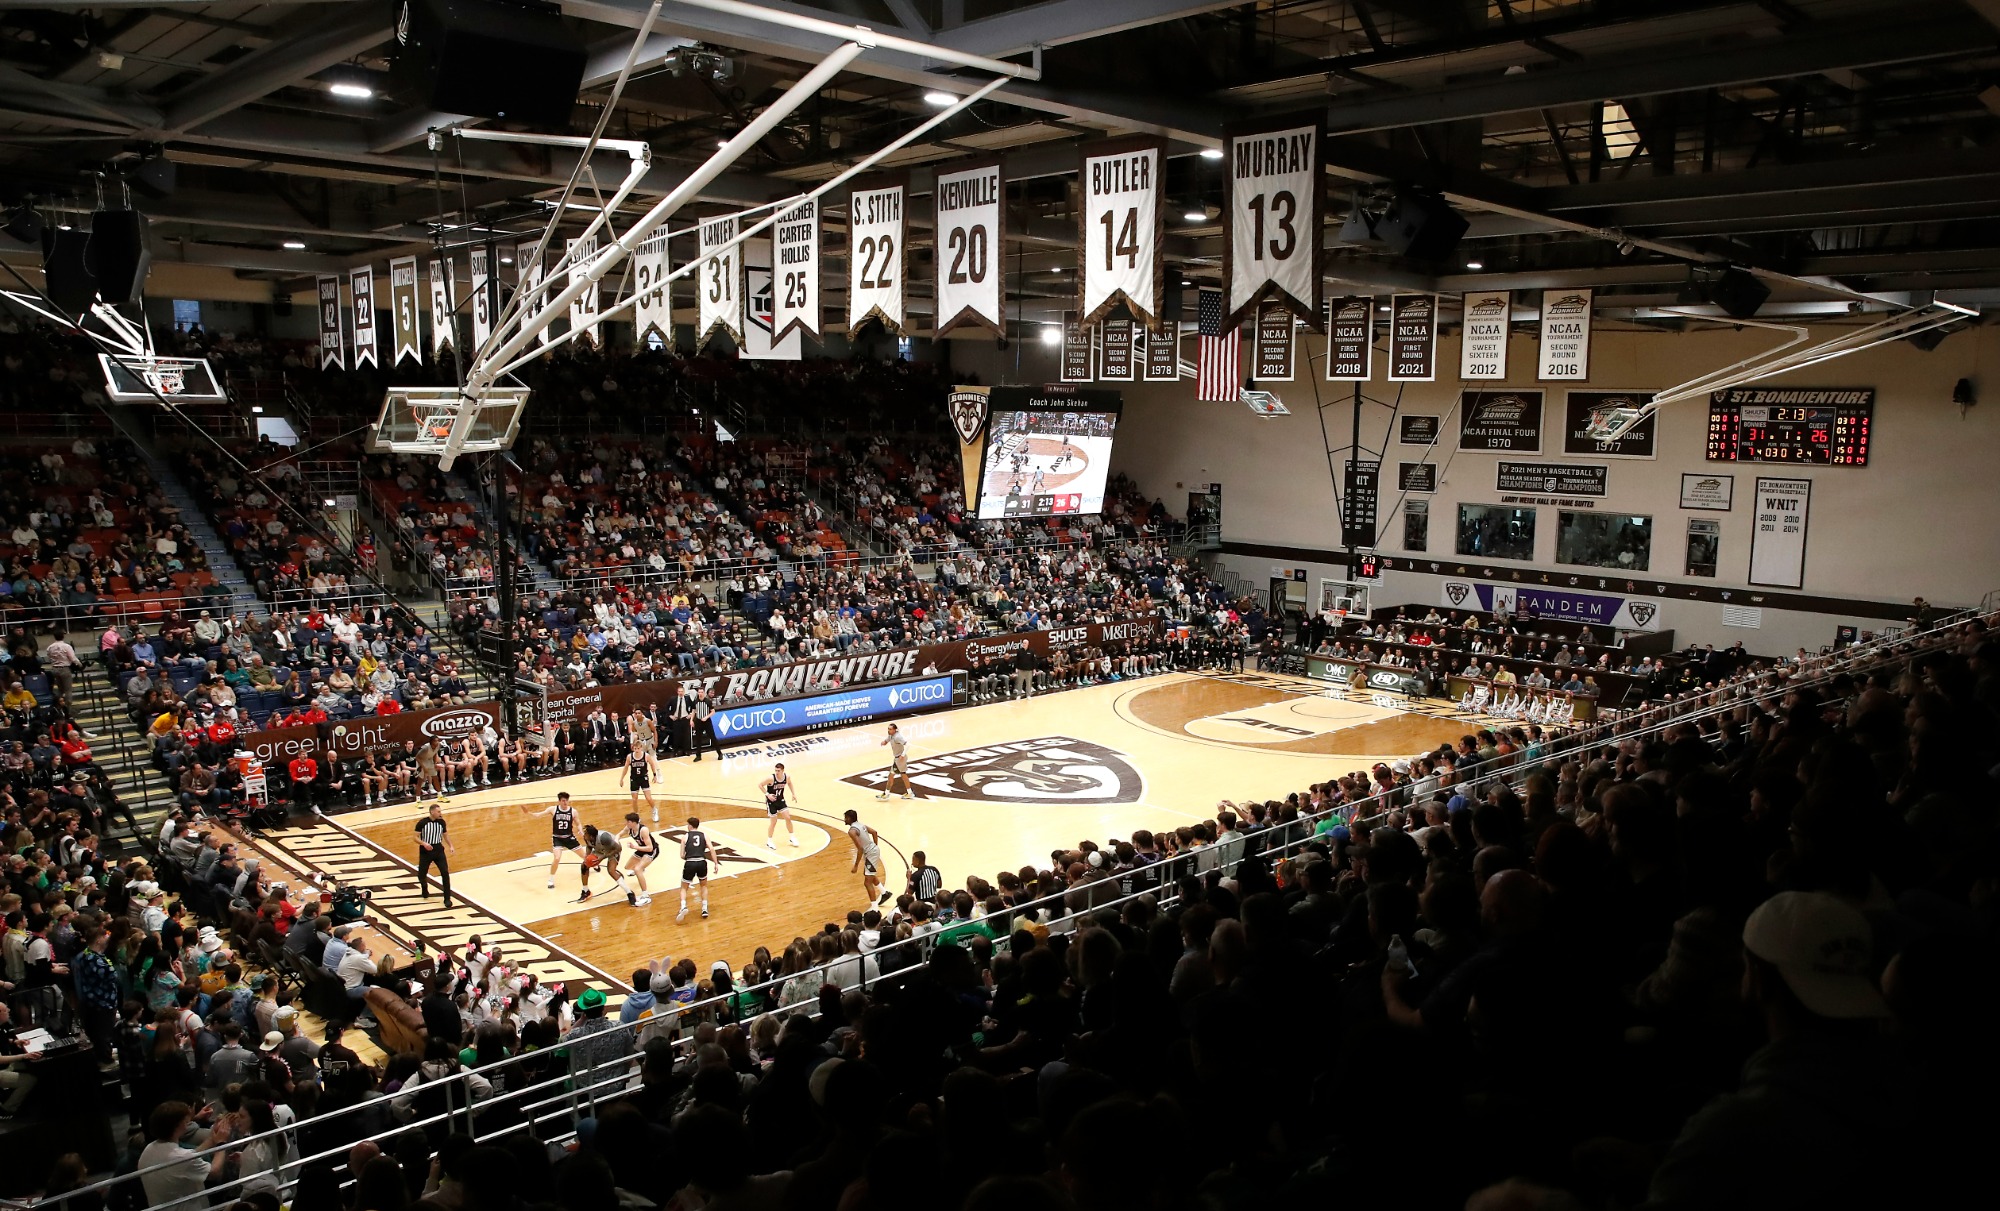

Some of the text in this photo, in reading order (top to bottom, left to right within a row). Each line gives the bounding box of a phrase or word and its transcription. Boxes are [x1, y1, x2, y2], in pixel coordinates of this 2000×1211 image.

[1236, 133, 1311, 180] MURRAY
[1092, 155, 1150, 197] BUTLER
[940, 175, 997, 211] KENVILLE
[854, 192, 900, 227] S. STITH
[1248, 190, 1297, 262] 13
[704, 219, 734, 247] LANIER
[780, 223, 812, 244] CARTER
[1100, 207, 1140, 272] 14
[781, 245, 810, 265] HOLLIS
[948, 224, 987, 285] 20
[859, 234, 894, 290] 22
[708, 255, 731, 304] 31
[639, 264, 663, 310] 34
[785, 272, 807, 309] 25
[325, 304, 335, 328] 42
[358, 298, 369, 324] 22
[402, 296, 410, 331] 5
[1263, 330, 1287, 339] NCAA
[1337, 328, 1363, 337] NCAA
[1400, 326, 1427, 336] NCAA
[1471, 325, 1500, 335] NCAA
[1550, 324, 1581, 334] NCAA
[1108, 334, 1127, 342] NCAA
[1068, 368, 1085, 377] 1961
[1107, 366, 1127, 375] 1968
[1152, 366, 1172, 375] 1978
[1263, 365, 1285, 375] 2012
[1336, 364, 1361, 374] 2018
[1399, 364, 1424, 374] 2021
[1470, 364, 1497, 375] 2012
[1548, 364, 1578, 375] 2016
[952, 394, 987, 403] BONNIES
[1030, 398, 1088, 407] Coach John Skehan
[1778, 409, 1805, 421] 2:13
[1750, 429, 1764, 441] 31
[1812, 431, 1828, 443] 26
[1488, 439, 1511, 448] 1970
[1596, 442, 1621, 452] 1977
[1766, 448, 1803, 458] 03 0 2
[1549, 468, 1593, 477] BASKETBALL
[1501, 481, 1543, 489] CHAMPIONS
[1558, 484, 1602, 492] CHAMPIONS
[1022, 500, 1031, 509] 31
[1039, 498, 1054, 507] 2:13
[1766, 498, 1799, 511] WNIT
[1784, 515, 1800, 523] 2010
[1362, 556, 1376, 565] 2:13
[1364, 565, 1373, 576] 14
[1049, 628, 1087, 643] SHULTS
[1102, 625, 1129, 642] M&T
[724, 650, 920, 701] BONAVENTURE
[1326, 664, 1346, 676] OMG
[901, 684, 944, 704] CUTCO
[537, 692, 602, 709] Oean General
[805, 700, 850, 711] AMERICAN-MADE
[807, 703, 869, 717] GUARANTEED FOREVER
[431, 714, 484, 730] mazza
[731, 708, 785, 731] CUTCO
[807, 715, 873, 731] GOBONNIES.COM
[364, 741, 400, 752] networks
[724, 736, 830, 760] BOB LANIER
[767, 745, 810, 758] COURT
[860, 737, 1079, 787] BONNIES
[559, 821, 568, 830] 23
[693, 835, 700, 847] 3
